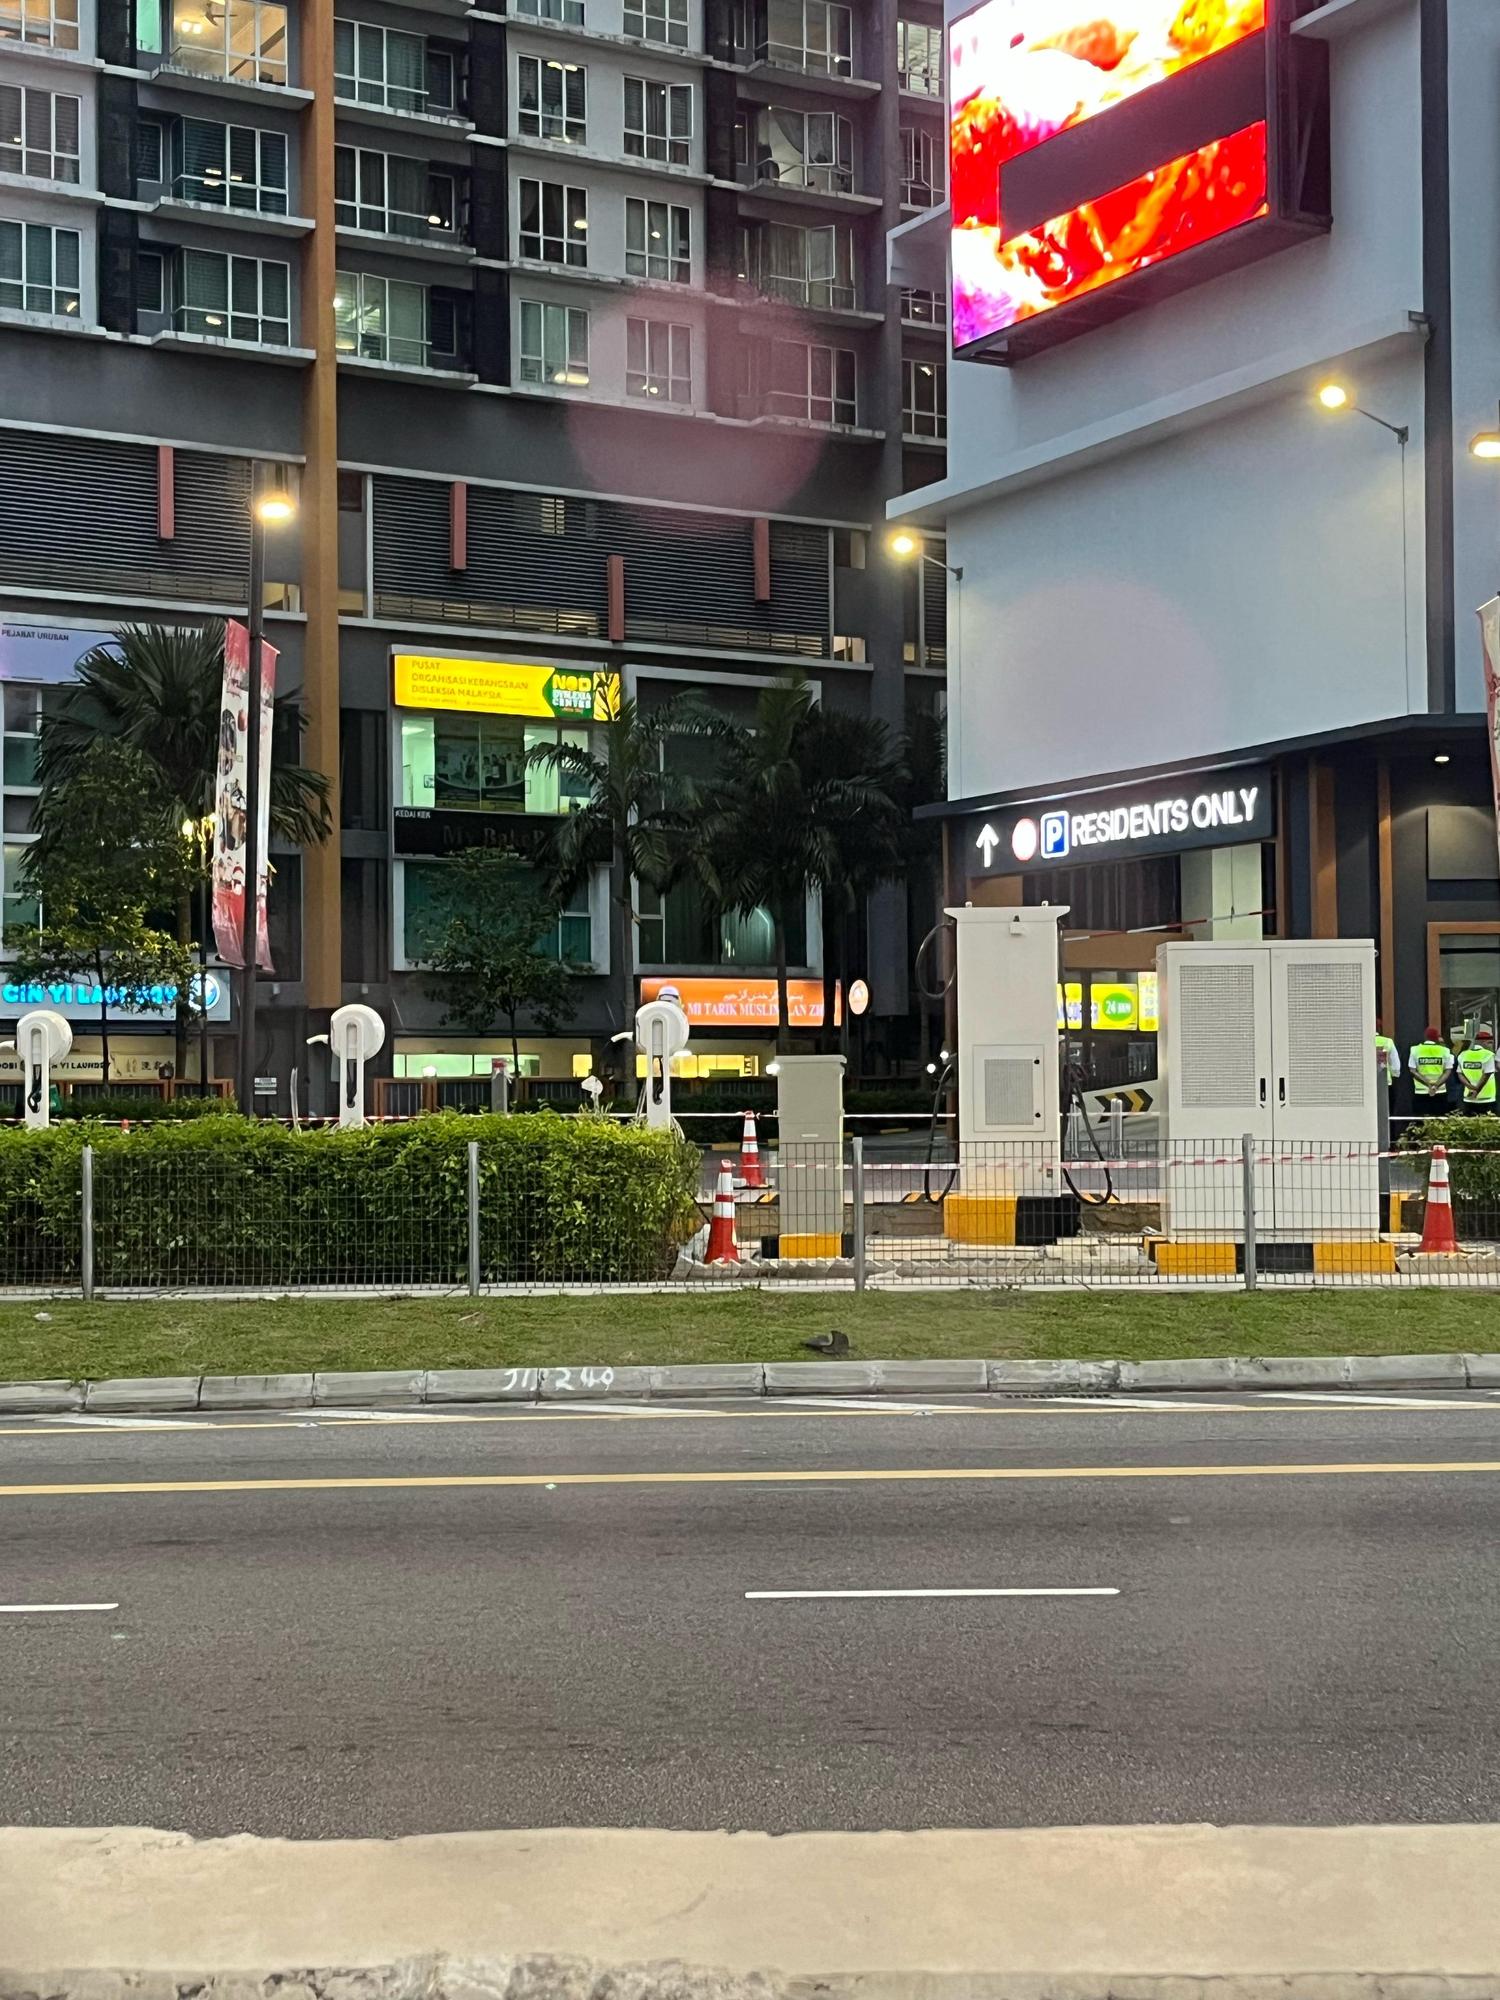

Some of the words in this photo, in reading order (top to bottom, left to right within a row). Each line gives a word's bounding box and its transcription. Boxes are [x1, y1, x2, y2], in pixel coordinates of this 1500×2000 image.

[411, 660, 440, 670] PUSAT
[457, 688, 501, 699] MALAYSIA
[1071, 799, 1189, 847] RESIDENTS
[1191, 787, 1258, 829] ONLY
[704, 1002, 737, 1017] TARIK
[1105, 1000, 1116, 1015] 24
